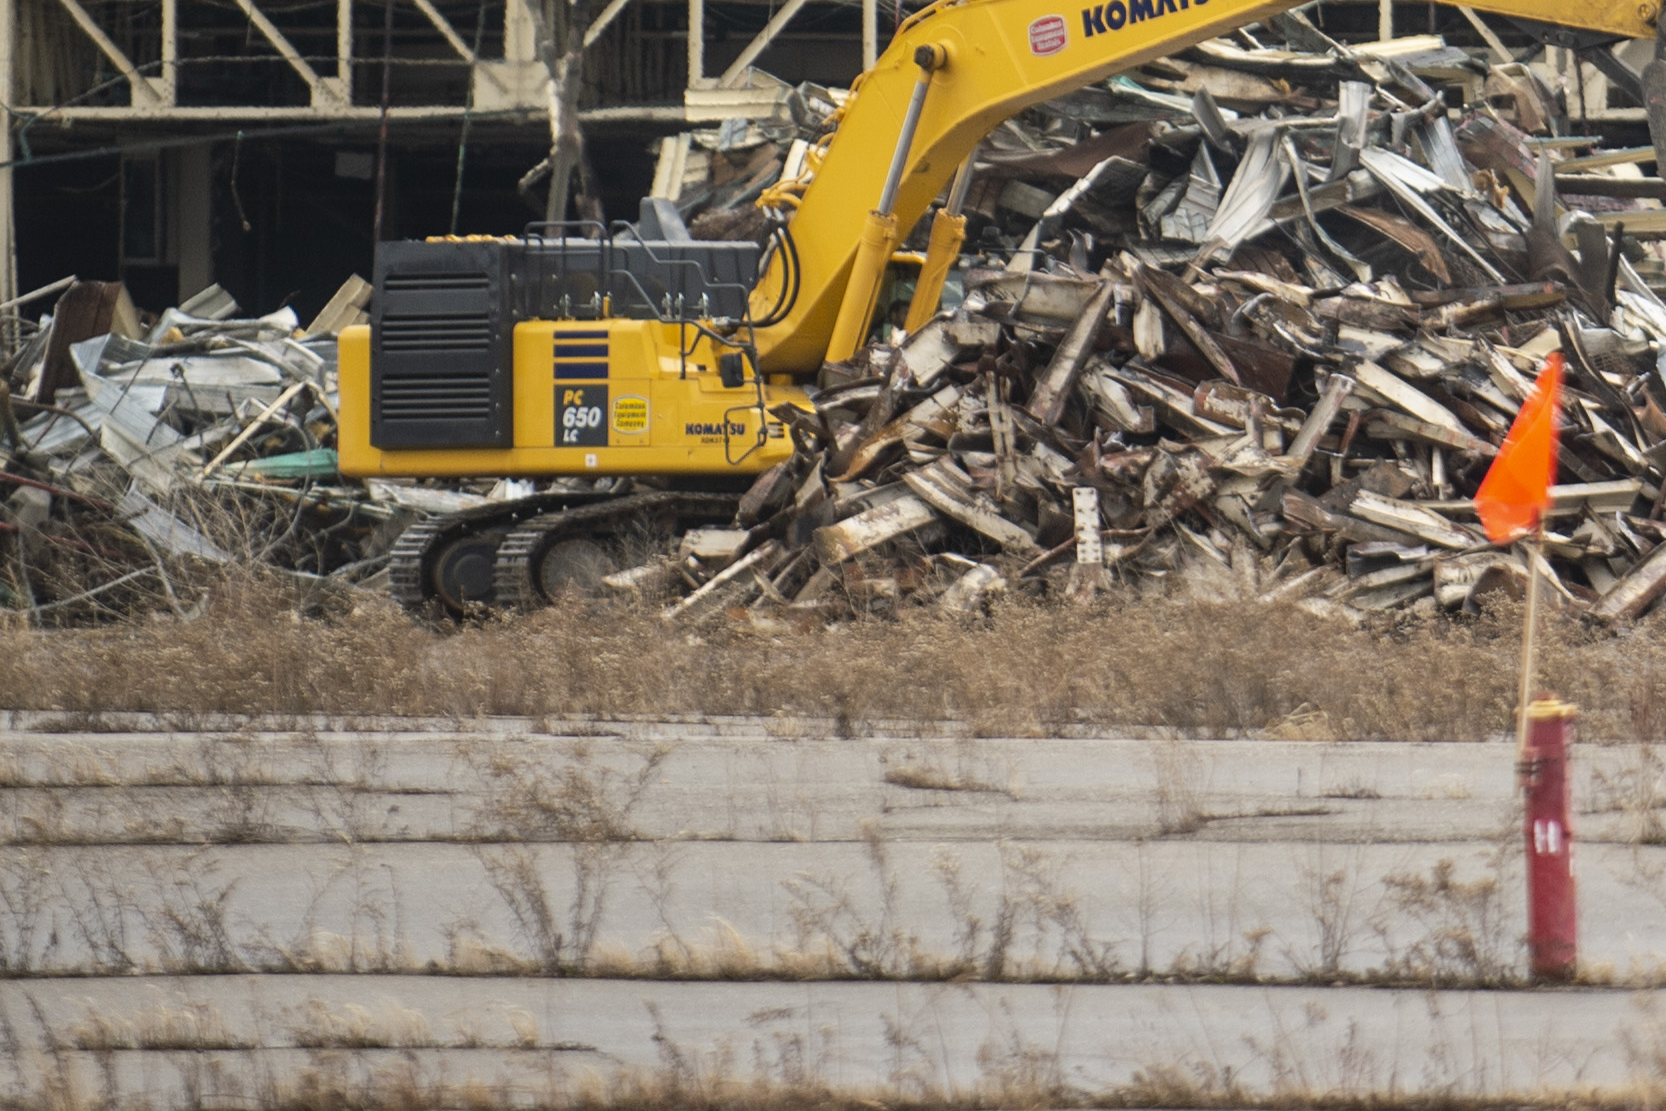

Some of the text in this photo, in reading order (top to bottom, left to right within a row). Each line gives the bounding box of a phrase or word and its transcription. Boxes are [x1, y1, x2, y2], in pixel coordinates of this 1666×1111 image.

[563, 389, 584, 406] PC
[562, 406, 601, 428] 650
[563, 429, 579, 442] LC
